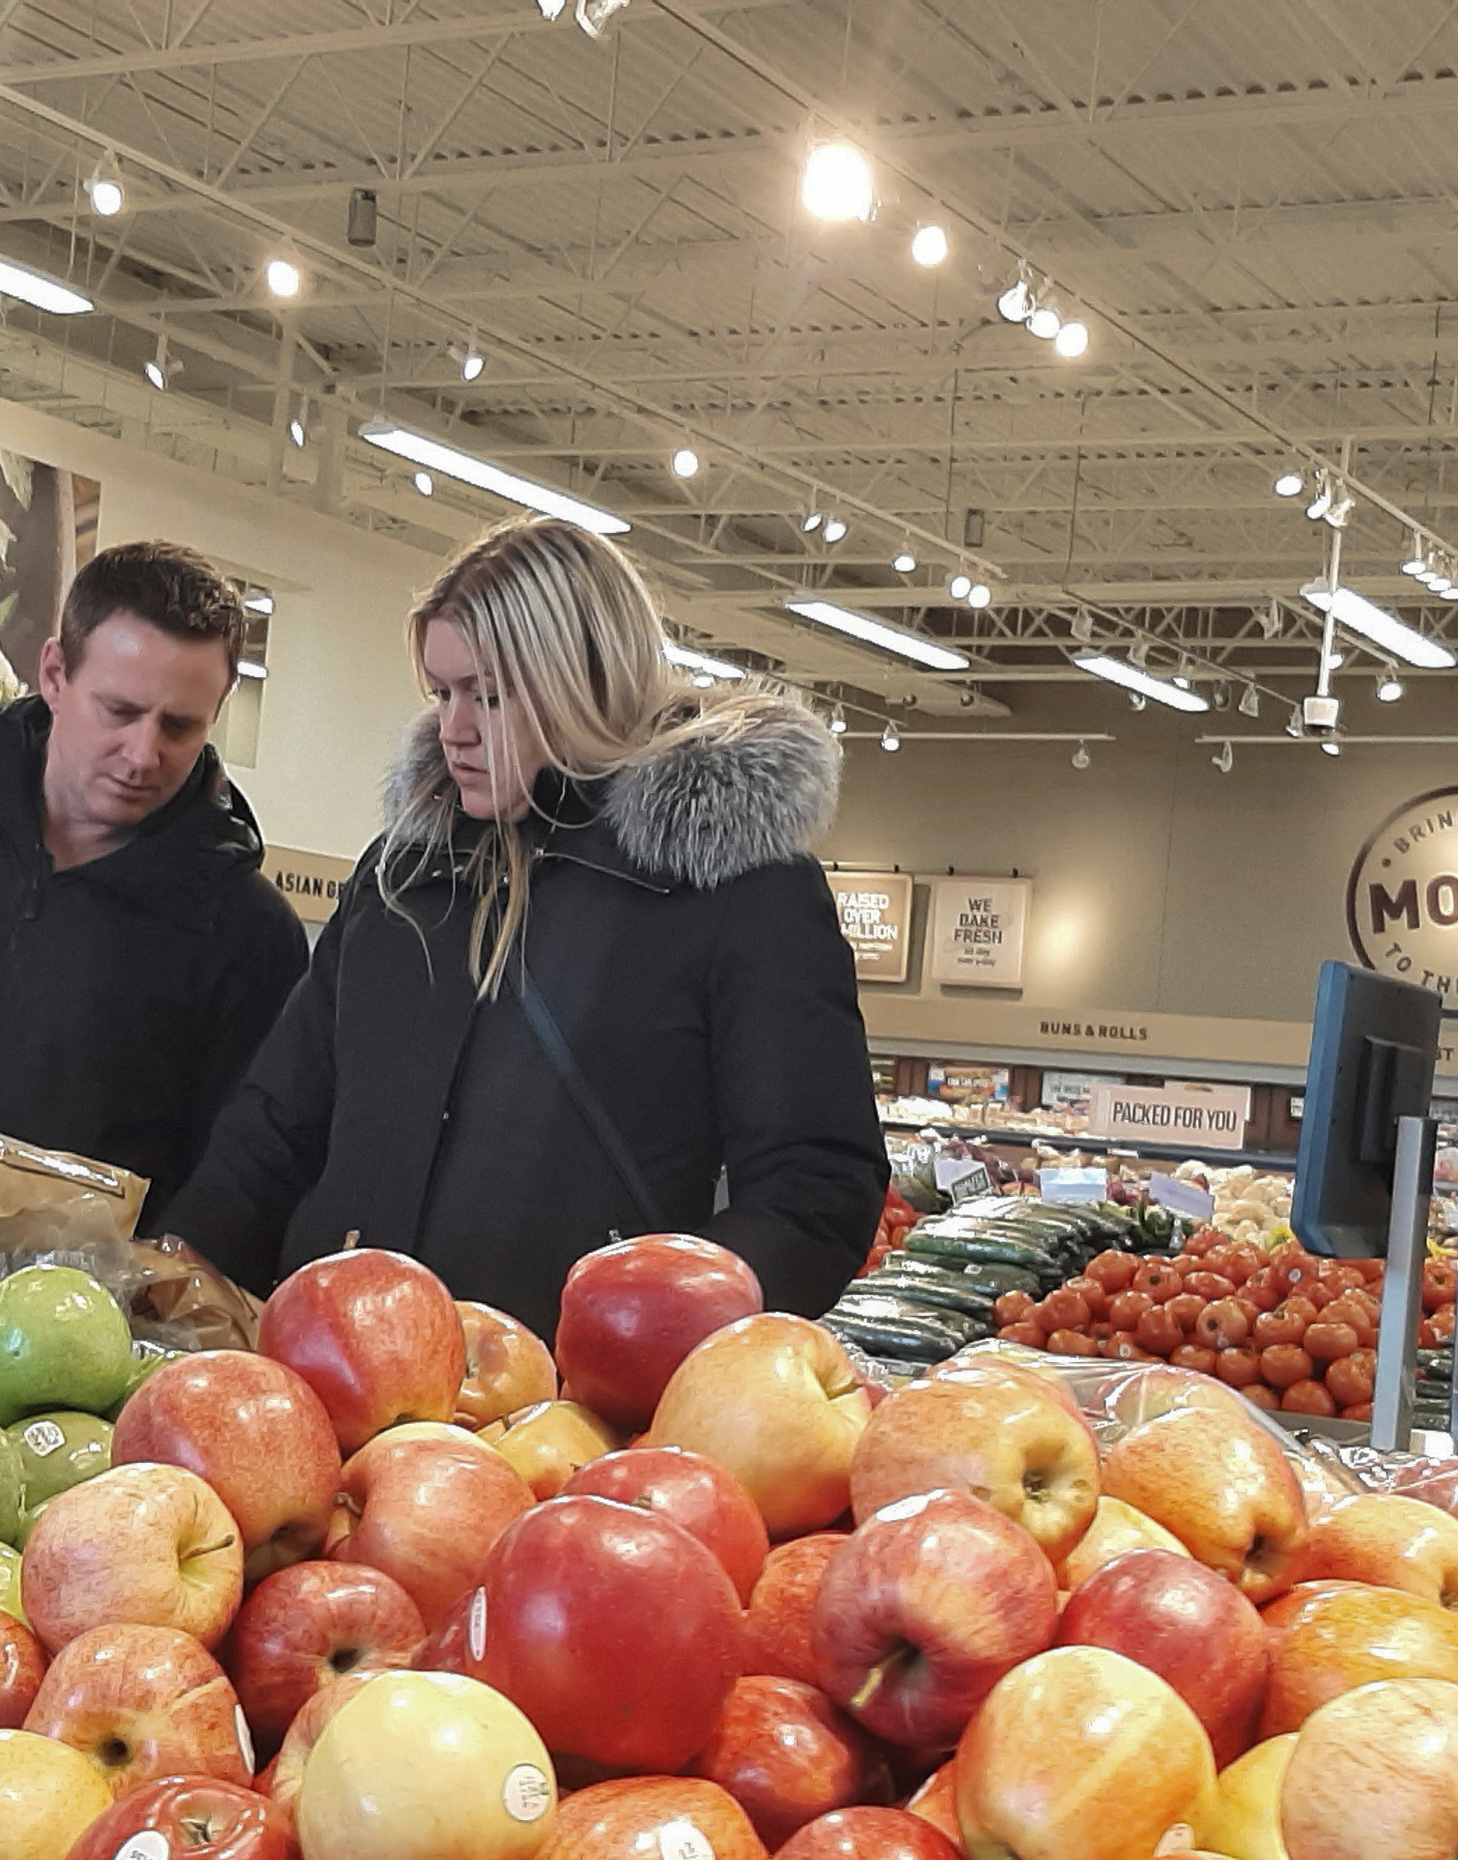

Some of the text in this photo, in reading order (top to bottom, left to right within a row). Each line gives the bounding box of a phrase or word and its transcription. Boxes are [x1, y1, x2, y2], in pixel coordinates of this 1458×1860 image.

[275, 871, 323, 897] ASIAN
[968, 897, 992, 913] WE
[843, 909, 882, 924] OVER
[954, 928, 1002, 945] FRESH
[1384, 941, 1458, 994] TO TH
[1040, 1021, 1081, 1036] BUNS
[1098, 1025, 1148, 1041] ROLLS
[1113, 1100, 1237, 1132] PACKED FOR YOU
